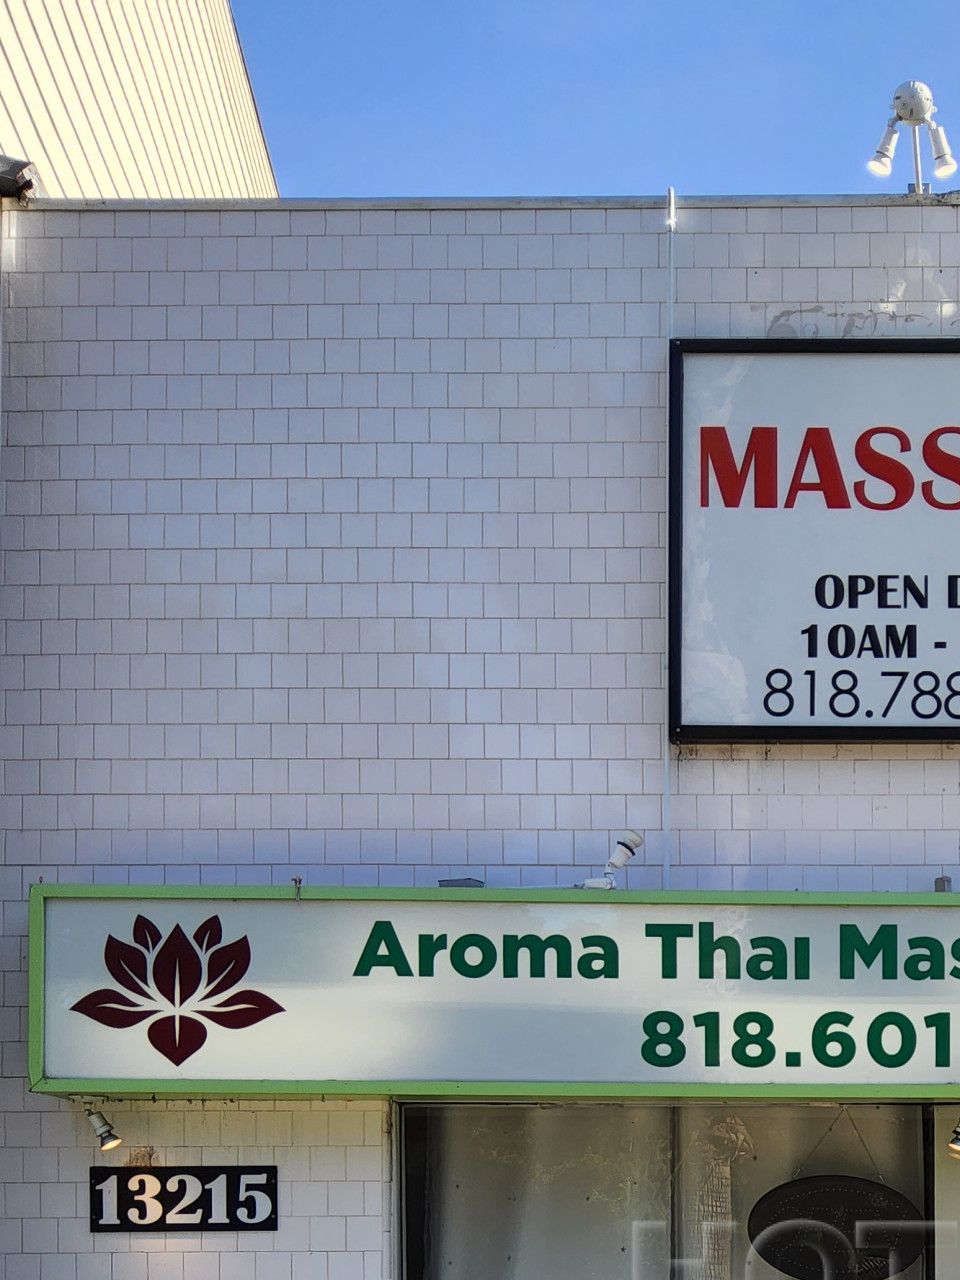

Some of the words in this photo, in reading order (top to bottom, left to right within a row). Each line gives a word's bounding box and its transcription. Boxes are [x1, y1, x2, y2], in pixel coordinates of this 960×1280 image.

[814, 574, 929, 609] OPEN
[800, 623, 917, 659] 10AM
[933, 641, 947, 649] -
[353, 920, 620, 980] Aroma
[645, 921, 811, 981] Thai
[95, 1173, 273, 1225] 13215
